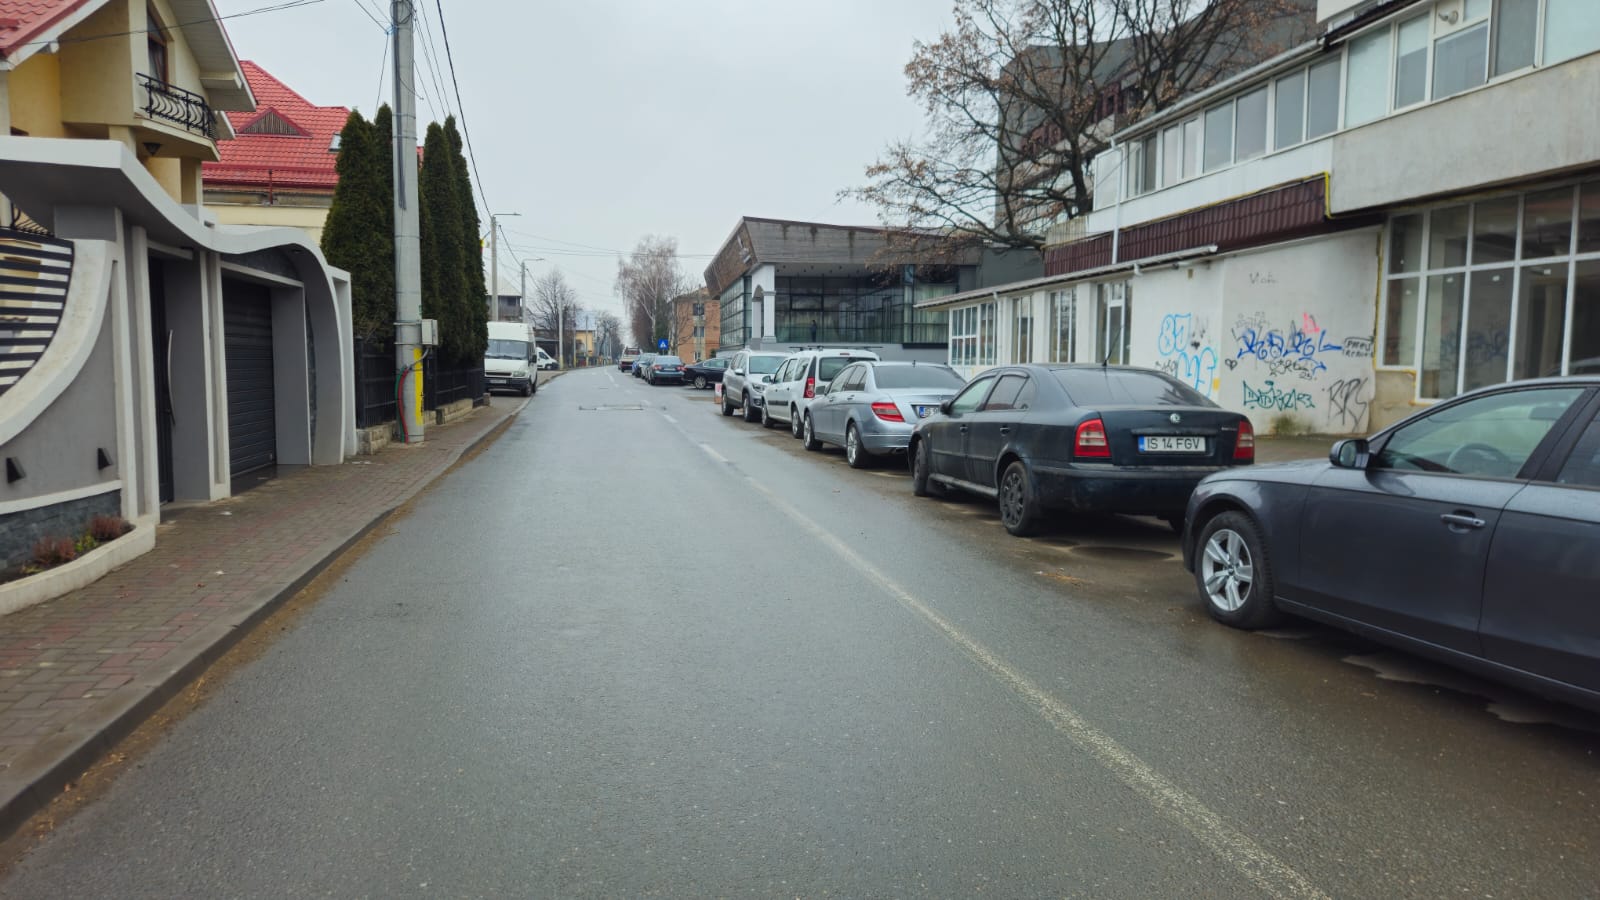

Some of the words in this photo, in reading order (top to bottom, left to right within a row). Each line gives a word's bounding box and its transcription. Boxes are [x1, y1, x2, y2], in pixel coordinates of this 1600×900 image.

[1147, 438, 1159, 450] IS
[1162, 438, 1173, 450] 14
[1176, 438, 1200, 450] FGV
